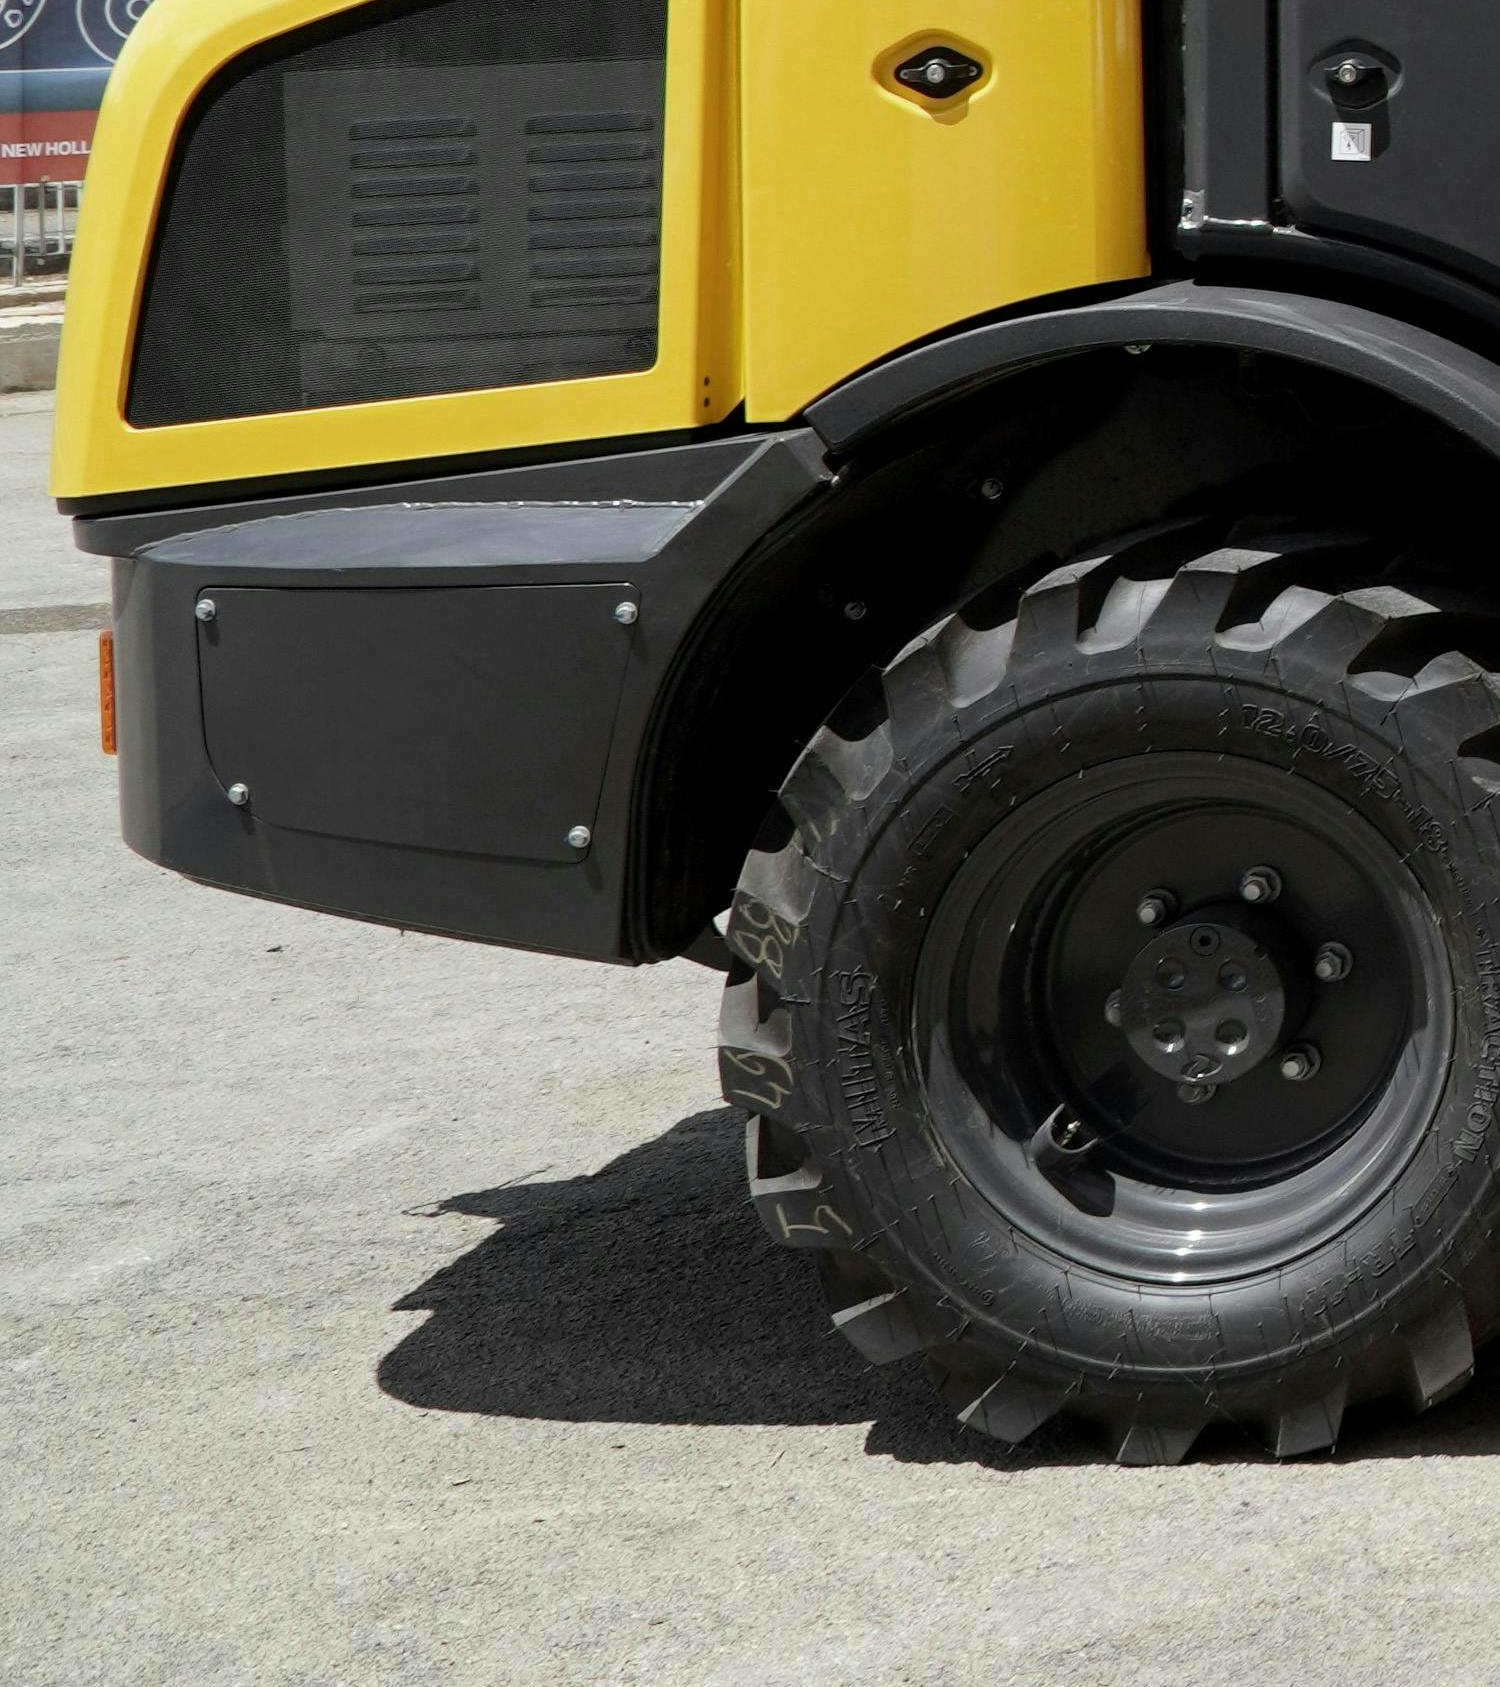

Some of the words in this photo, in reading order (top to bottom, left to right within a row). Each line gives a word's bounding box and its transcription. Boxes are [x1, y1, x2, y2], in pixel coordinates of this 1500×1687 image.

[1, 142, 42, 158] NEW
[45, 140, 92, 156] HOLL
[836, 969, 899, 1152] MITAS
